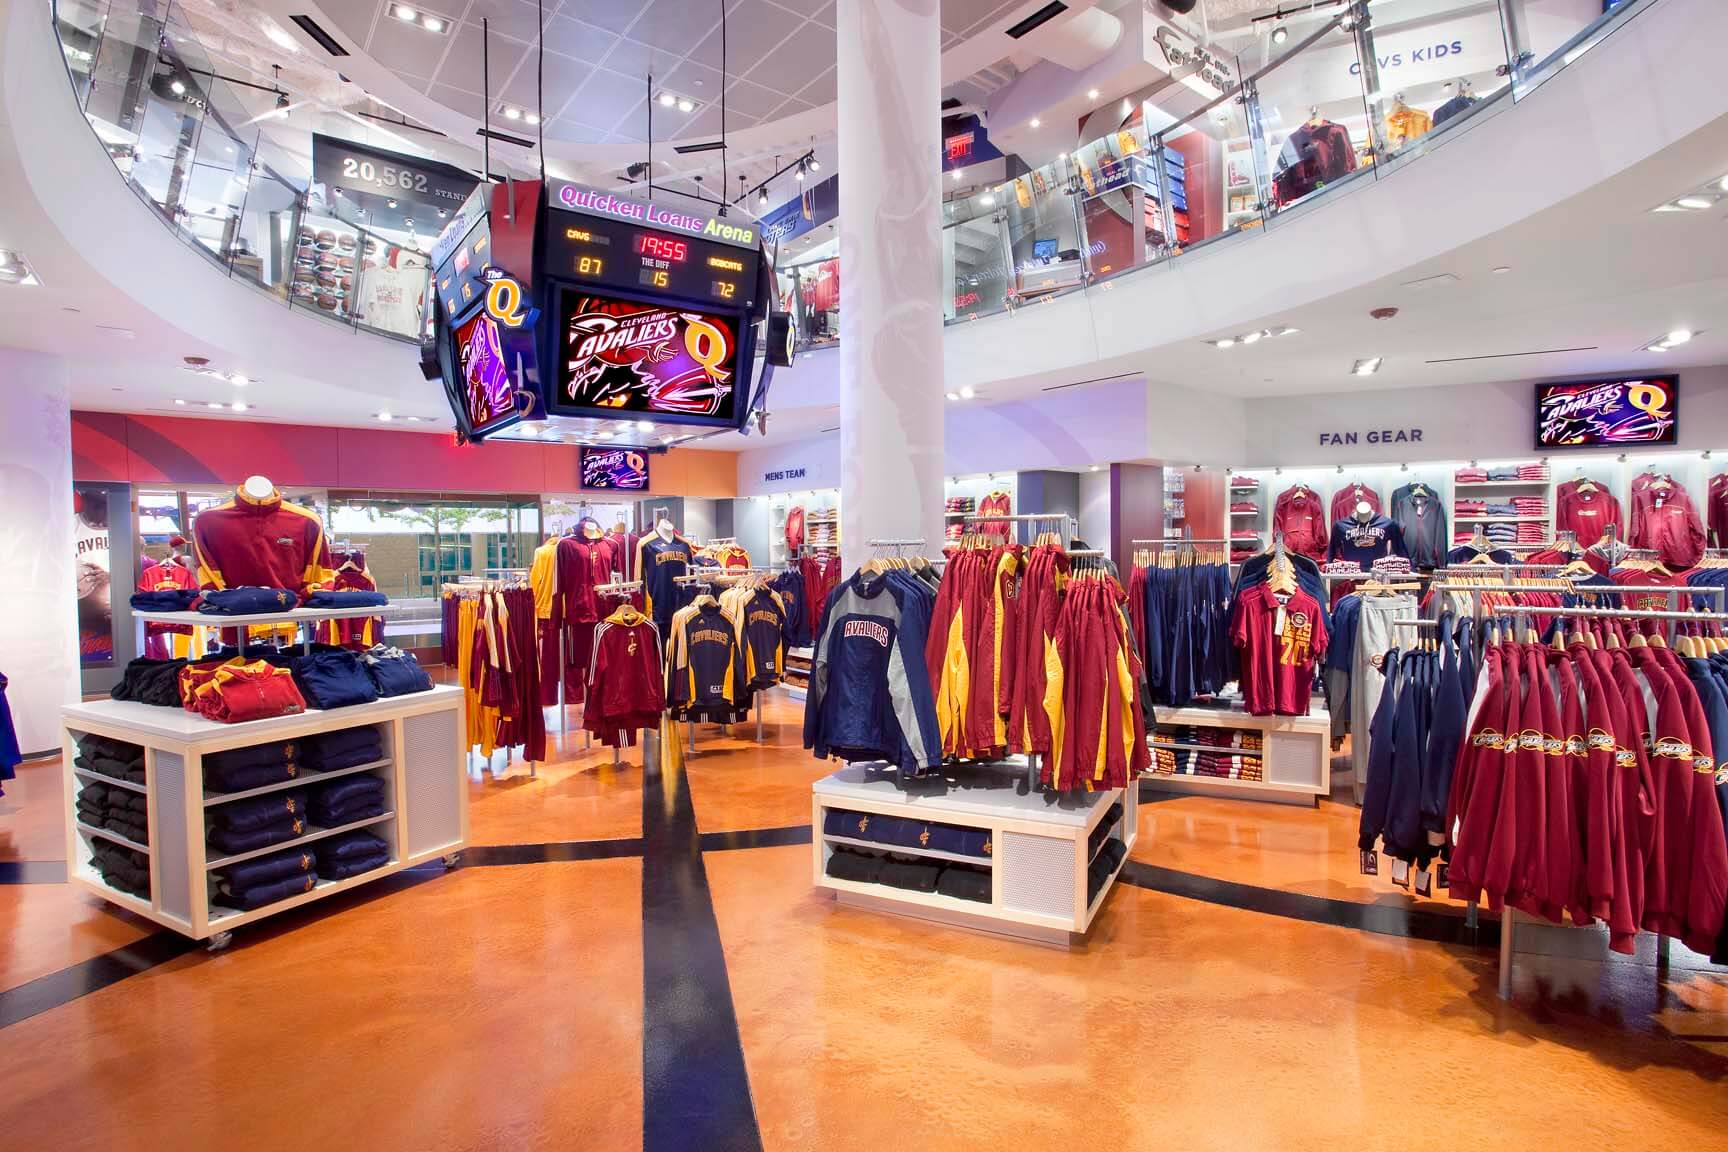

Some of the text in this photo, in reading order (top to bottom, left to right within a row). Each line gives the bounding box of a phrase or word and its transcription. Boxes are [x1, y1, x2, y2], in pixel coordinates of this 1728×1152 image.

[1349, 40, 1463, 76] CVS KIDS
[343, 158, 428, 193] 20,562
[560, 185, 645, 219] Quicken
[647, 204, 704, 232] Loans
[704, 218, 753, 244] Arena
[641, 236, 685, 261] 19:55
[579, 257, 602, 275] 87
[641, 256, 671, 271] THE DIFF
[487, 270, 503, 279] The
[653, 271, 669, 287] 15
[717, 281, 735, 299] 72
[487, 279, 526, 327] Q
[620, 312, 667, 328] CLEVELAND
[680, 313, 731, 380] Q
[1624, 381, 1671, 418] Q
[1319, 428, 1423, 446] FAN GEAR
[765, 468, 806, 482] MENS TEAM
